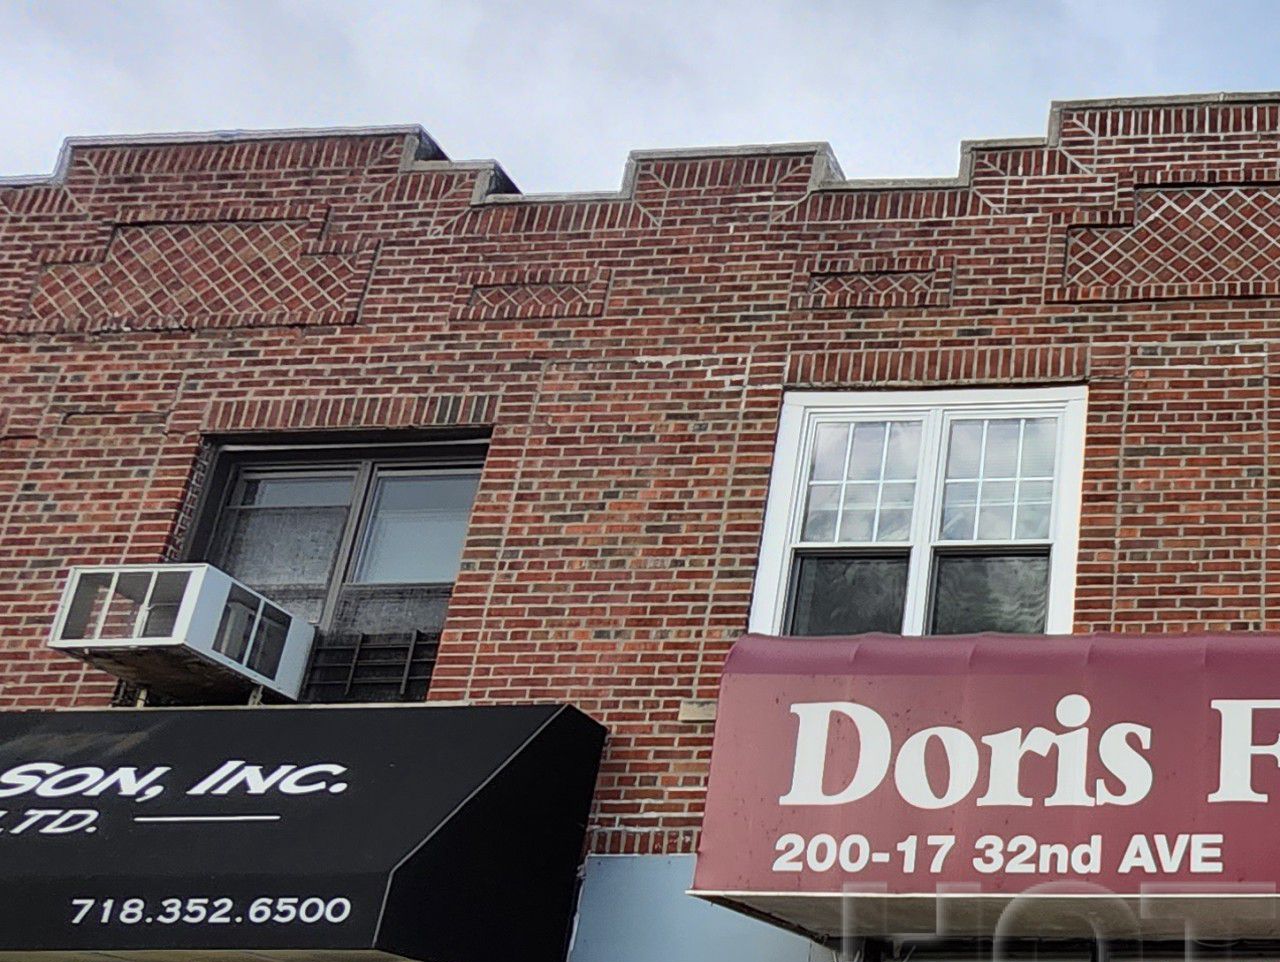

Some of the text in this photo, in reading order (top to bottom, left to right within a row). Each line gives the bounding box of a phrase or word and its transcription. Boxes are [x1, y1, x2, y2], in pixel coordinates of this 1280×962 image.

[779, 694, 1153, 809] Doris
[186, 760, 348, 796] INC.
[0, 809, 99, 834] TD.
[771, 833, 955, 874] 200-17
[972, 834, 1102, 874] 32nd
[1118, 834, 1224, 874] AVE
[71, 897, 351, 924] 718.352.6500
